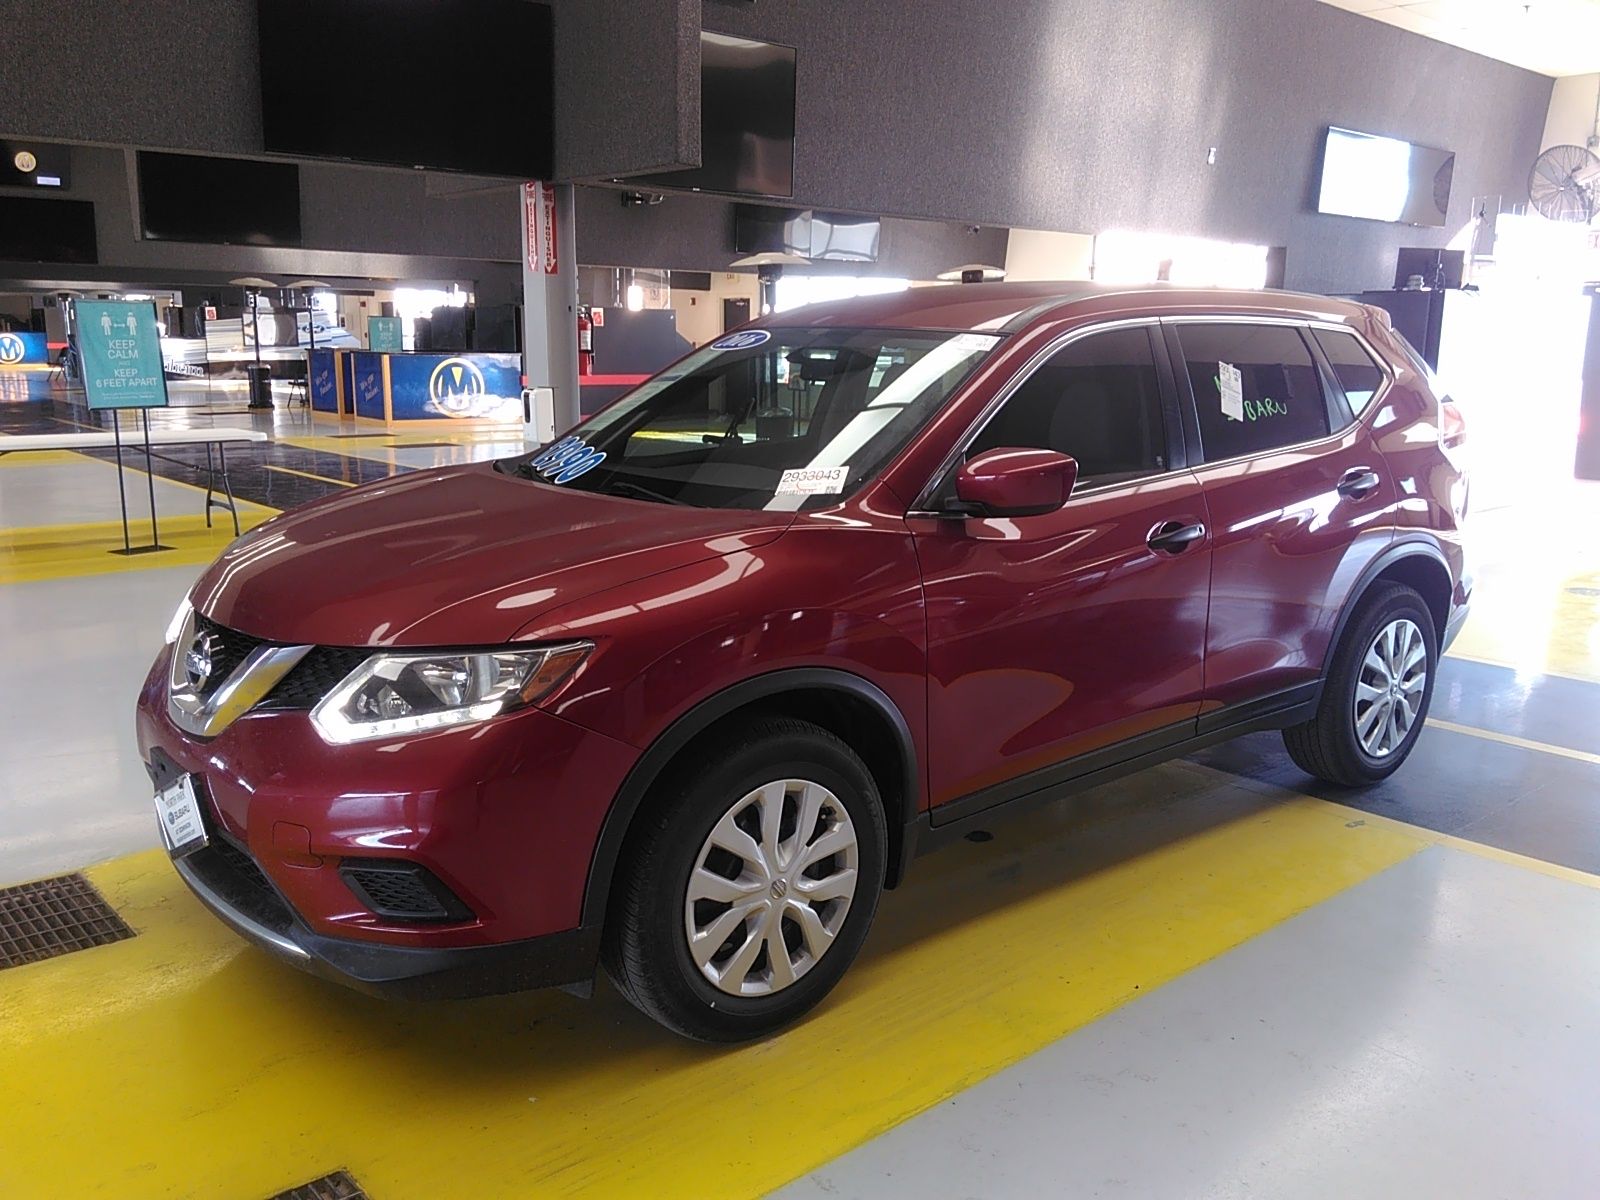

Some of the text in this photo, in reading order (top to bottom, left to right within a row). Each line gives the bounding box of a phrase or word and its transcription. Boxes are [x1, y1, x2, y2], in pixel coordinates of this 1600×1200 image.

[108, 339, 136, 350] KEEP
[107, 349, 139, 360] CALM
[114, 368, 138, 378] KEEP
[96, 377, 158, 388] 6 FEET APART
[782, 469, 842, 483] 2933043
